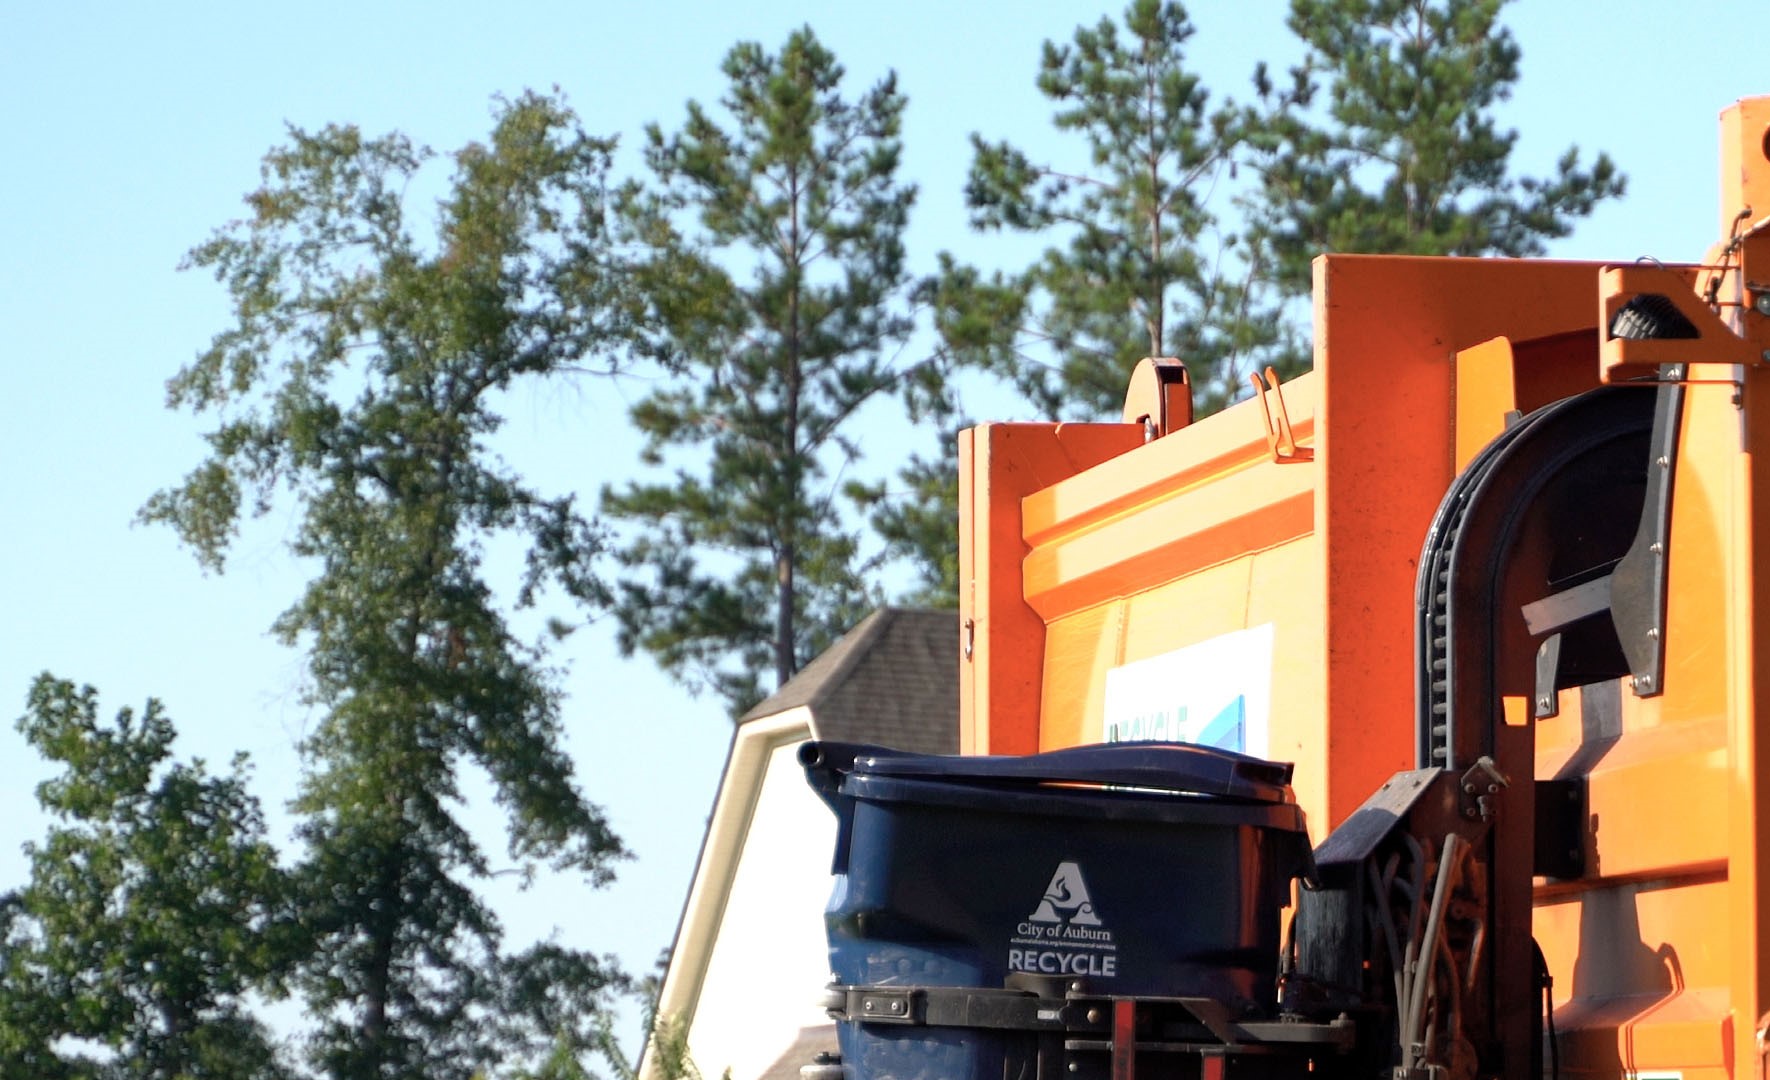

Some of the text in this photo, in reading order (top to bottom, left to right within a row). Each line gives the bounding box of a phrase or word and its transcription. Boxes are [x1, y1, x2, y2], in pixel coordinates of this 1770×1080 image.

[1017, 922, 1111, 941] City of Auburn
[1008, 949, 1116, 977] RECYCLE
